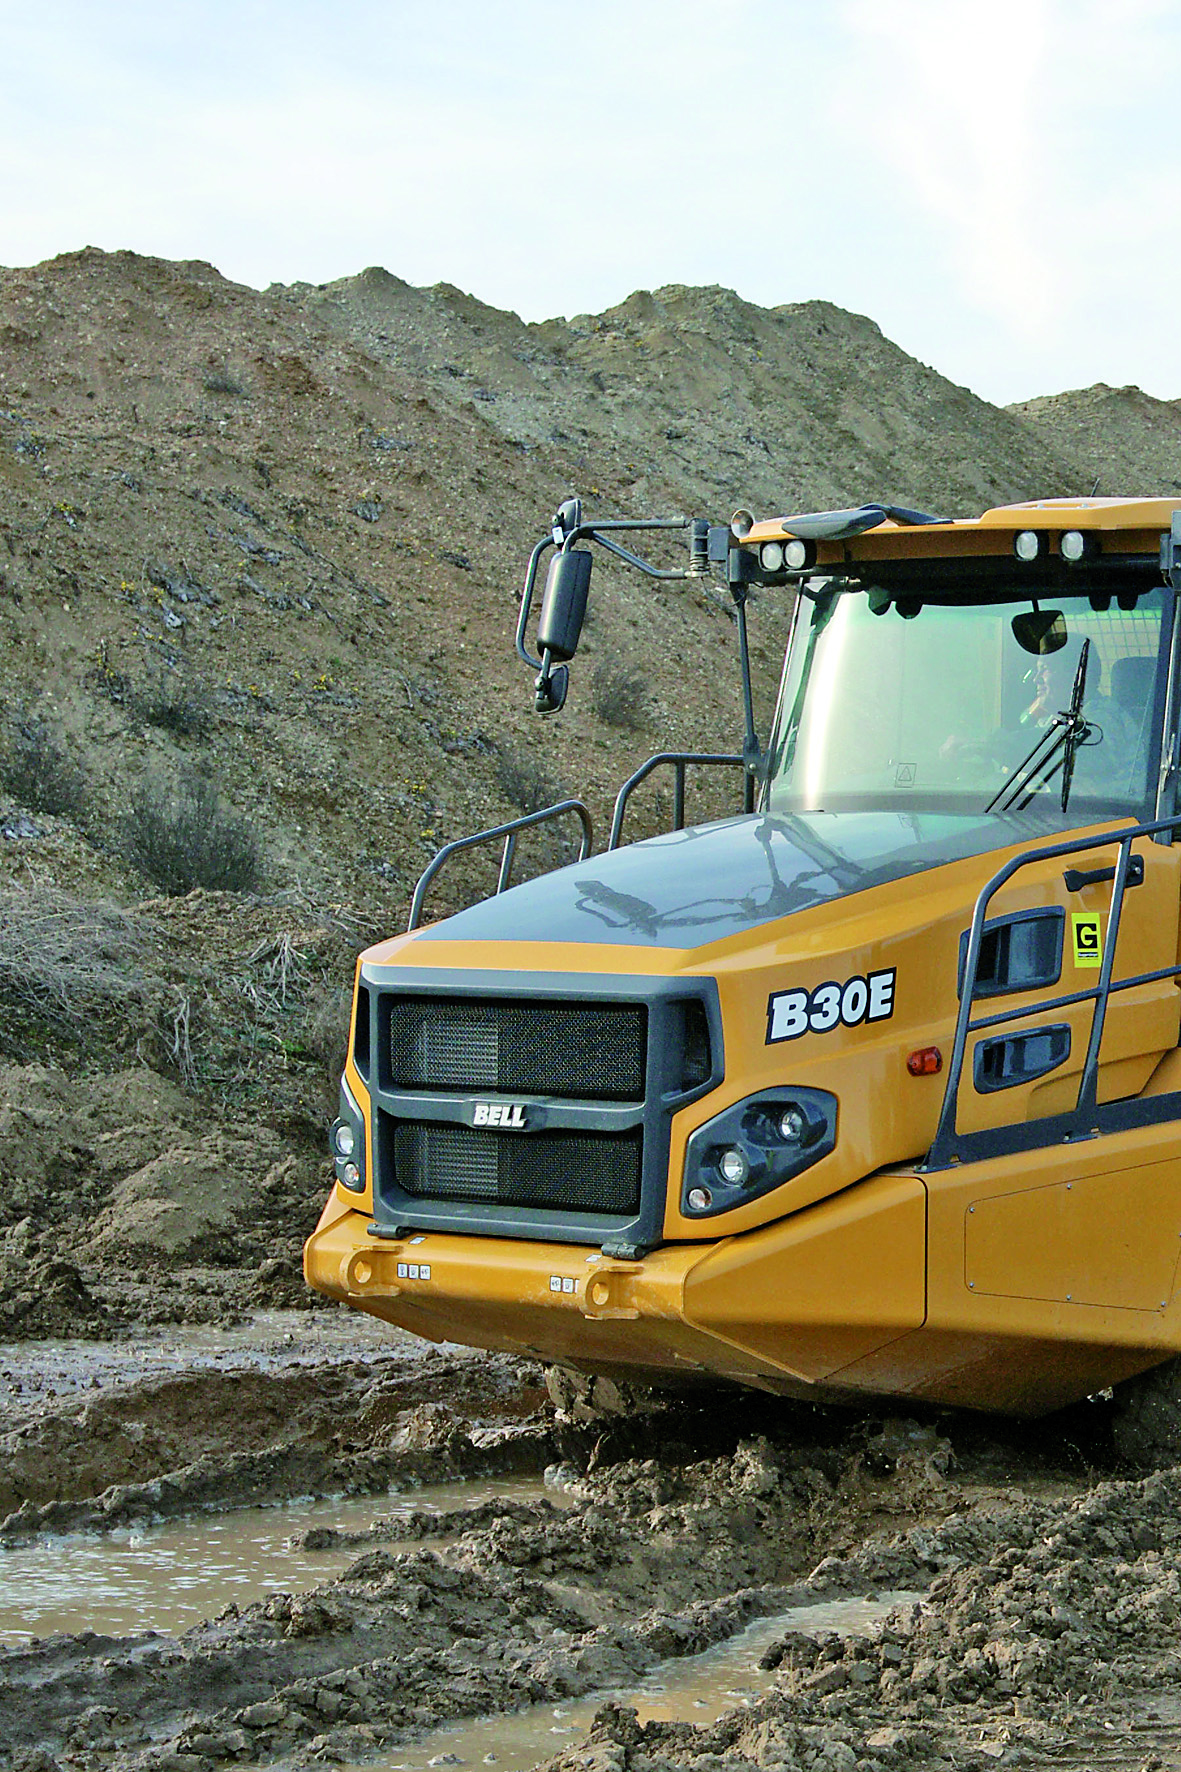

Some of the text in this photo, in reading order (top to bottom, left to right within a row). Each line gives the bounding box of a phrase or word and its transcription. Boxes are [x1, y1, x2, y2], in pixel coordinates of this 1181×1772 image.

[1076, 923, 1098, 949] G
[768, 970, 895, 1042] B30E
[473, 1104, 526, 1127] BELL
